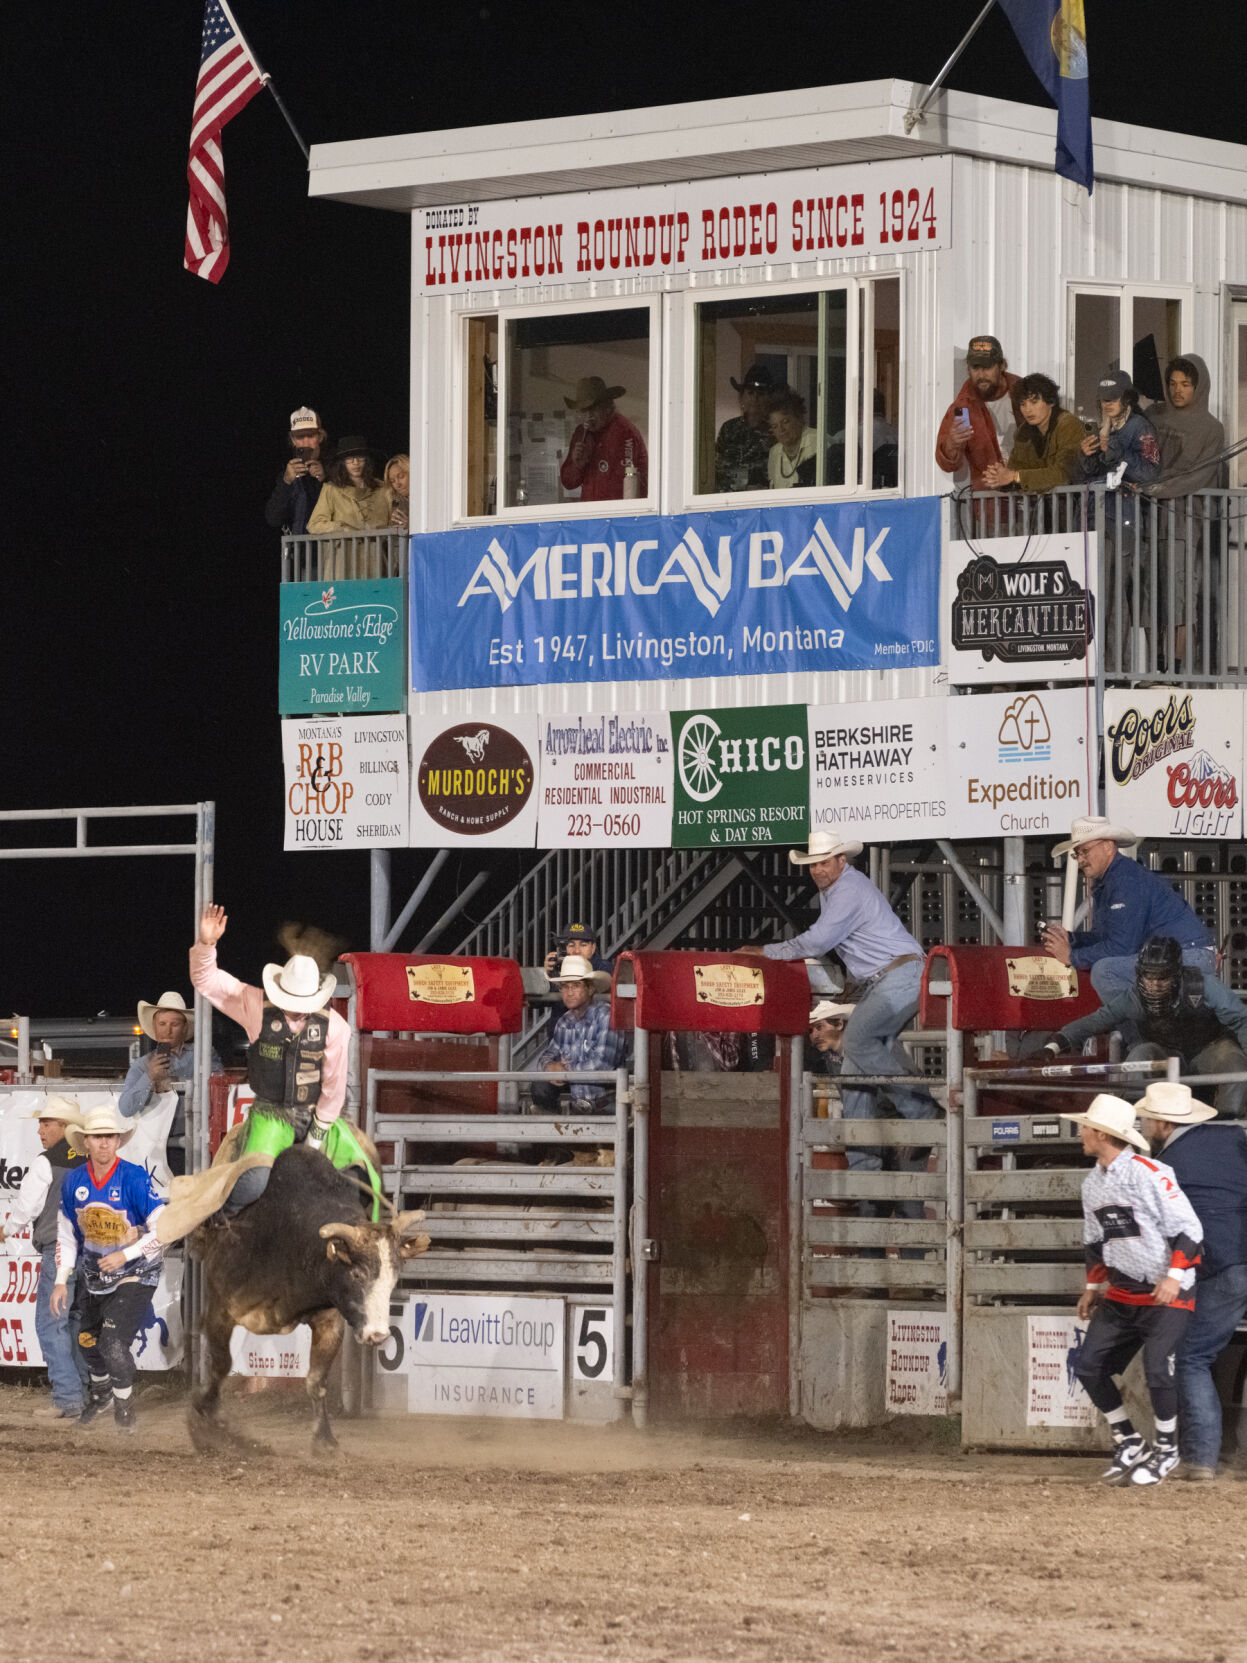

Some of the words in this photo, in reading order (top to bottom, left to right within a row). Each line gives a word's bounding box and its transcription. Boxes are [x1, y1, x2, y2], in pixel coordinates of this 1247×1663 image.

[426, 208, 464, 230] DONATED
[468, 206, 479, 226] BY
[425, 223, 563, 286] LIVINGSTON
[577, 211, 689, 272] ROUNDUP
[702, 201, 778, 261] RODEO
[792, 193, 865, 252] SINCE
[879, 186, 938, 245] 1924
[457, 526, 733, 619] AMERICAN
[749, 517, 894, 613] BANK
[283, 614, 362, 641] Yellowstone's
[362, 613, 394, 645] Edge
[961, 603, 1086, 637] MERCANTILE
[489, 637, 524, 665] Est
[534, 634, 595, 667] 1947,
[602, 630, 734, 667] Livingston,
[743, 624, 845, 653] Montana
[874, 643, 910, 656] Member
[911, 640, 936, 653] FDIC
[299, 653, 325, 677] RV
[328, 651, 380, 676] PARK
[310, 687, 344, 704] Paradise
[346, 686, 371, 707] Valley
[298, 727, 342, 740] MONTANA'S
[354, 730, 404, 743] LIVINGSTON
[545, 715, 605, 756] Arrowhead
[608, 715, 653, 755] Electric
[815, 723, 913, 749] BERKSHIRE
[1107, 693, 1197, 787] Coors
[298, 742, 343, 778] RIB
[677, 714, 805, 802] CHICO
[816, 747, 913, 772] HATHAWAY
[1132, 728, 1194, 780] ORIGINAL
[428, 768, 525, 796] MURDOCH'S
[574, 762, 636, 781] COMMERCIAL
[816, 771, 914, 788] HOMESERVICES
[544, 787, 603, 805] RESIDENTIAL
[610, 786, 666, 804] INDUSTRIAL
[968, 774, 1081, 810] Expedition
[1166, 762, 1239, 809] Coors
[288, 781, 354, 816] CHOP
[365, 793, 393, 806] CODY
[438, 805, 459, 822] RANCH
[485, 805, 510, 822] SUPPLY
[678, 810, 704, 825] HOT
[706, 808, 756, 824] SPRINGS
[759, 805, 805, 822] RESORT
[815, 805, 872, 824] MONTANA
[874, 800, 947, 820] PROPERTIES
[1000, 812, 1049, 831] Church
[1169, 810, 1234, 836] LIGHT
[295, 818, 344, 842] HOUSE
[356, 824, 401, 838] SHERIDAN
[567, 813, 641, 837] 223-0560
[710, 828, 720, 843] &
[725, 827, 749, 842] DAY
[751, 826, 773, 841] SPA
[440, 1307, 555, 1356] LeavittGroup
[891, 1319, 940, 1342] LIVINGSTON
[576, 1309, 608, 1379] 5
[279, 1353, 300, 1369] 1924
[891, 1349, 930, 1372] ROUNDUP
[434, 1383, 535, 1405] INSURANCE
[889, 1379, 917, 1405] RODEO
